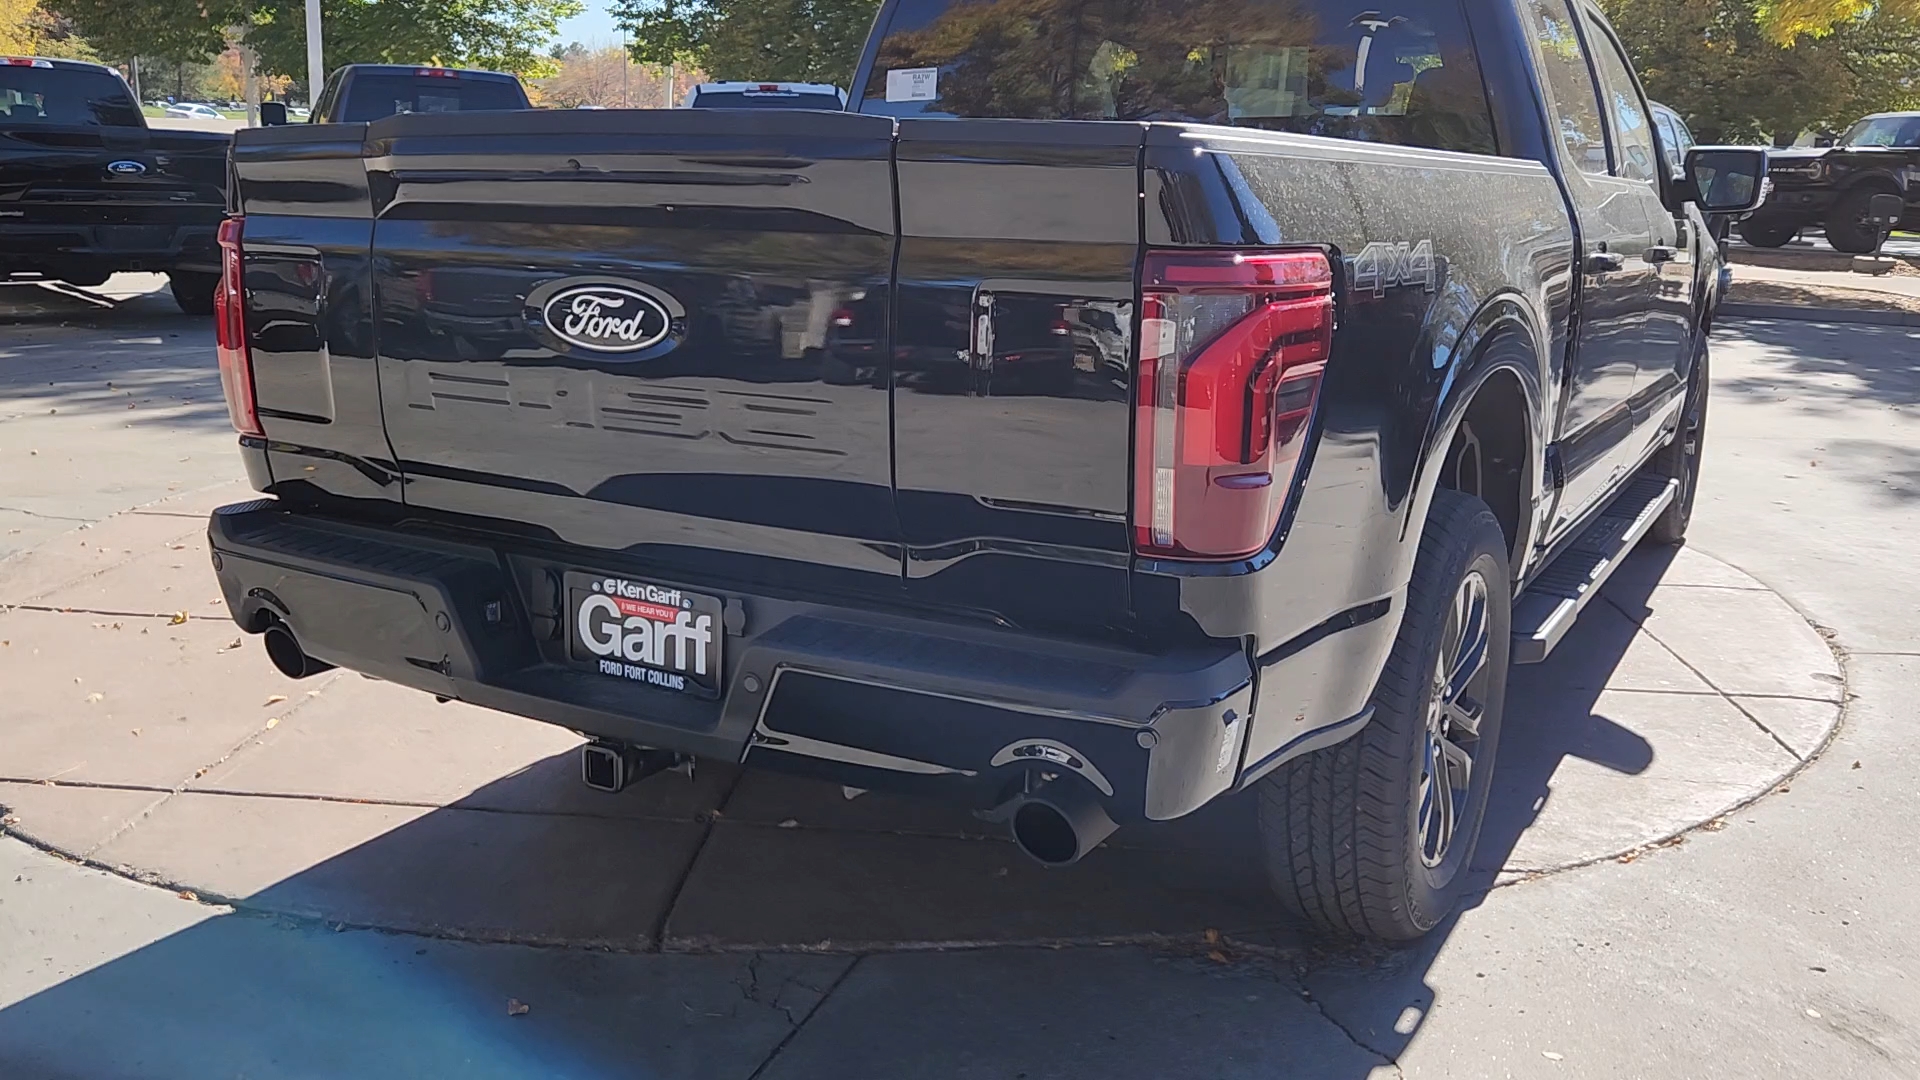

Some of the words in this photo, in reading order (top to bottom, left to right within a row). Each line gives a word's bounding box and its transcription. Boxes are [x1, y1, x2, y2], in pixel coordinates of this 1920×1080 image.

[1353, 240, 1436, 298] 4X4
[564, 294, 645, 341] Ford
[626, 603, 637, 612] WE
[637, 605, 655, 614] HEAR
[655, 608, 669, 617] YOU
[578, 594, 712, 675] Garff
[599, 659, 623, 676] FORD
[624, 664, 647, 682] FORT
[647, 669, 684, 691] COLLINS
